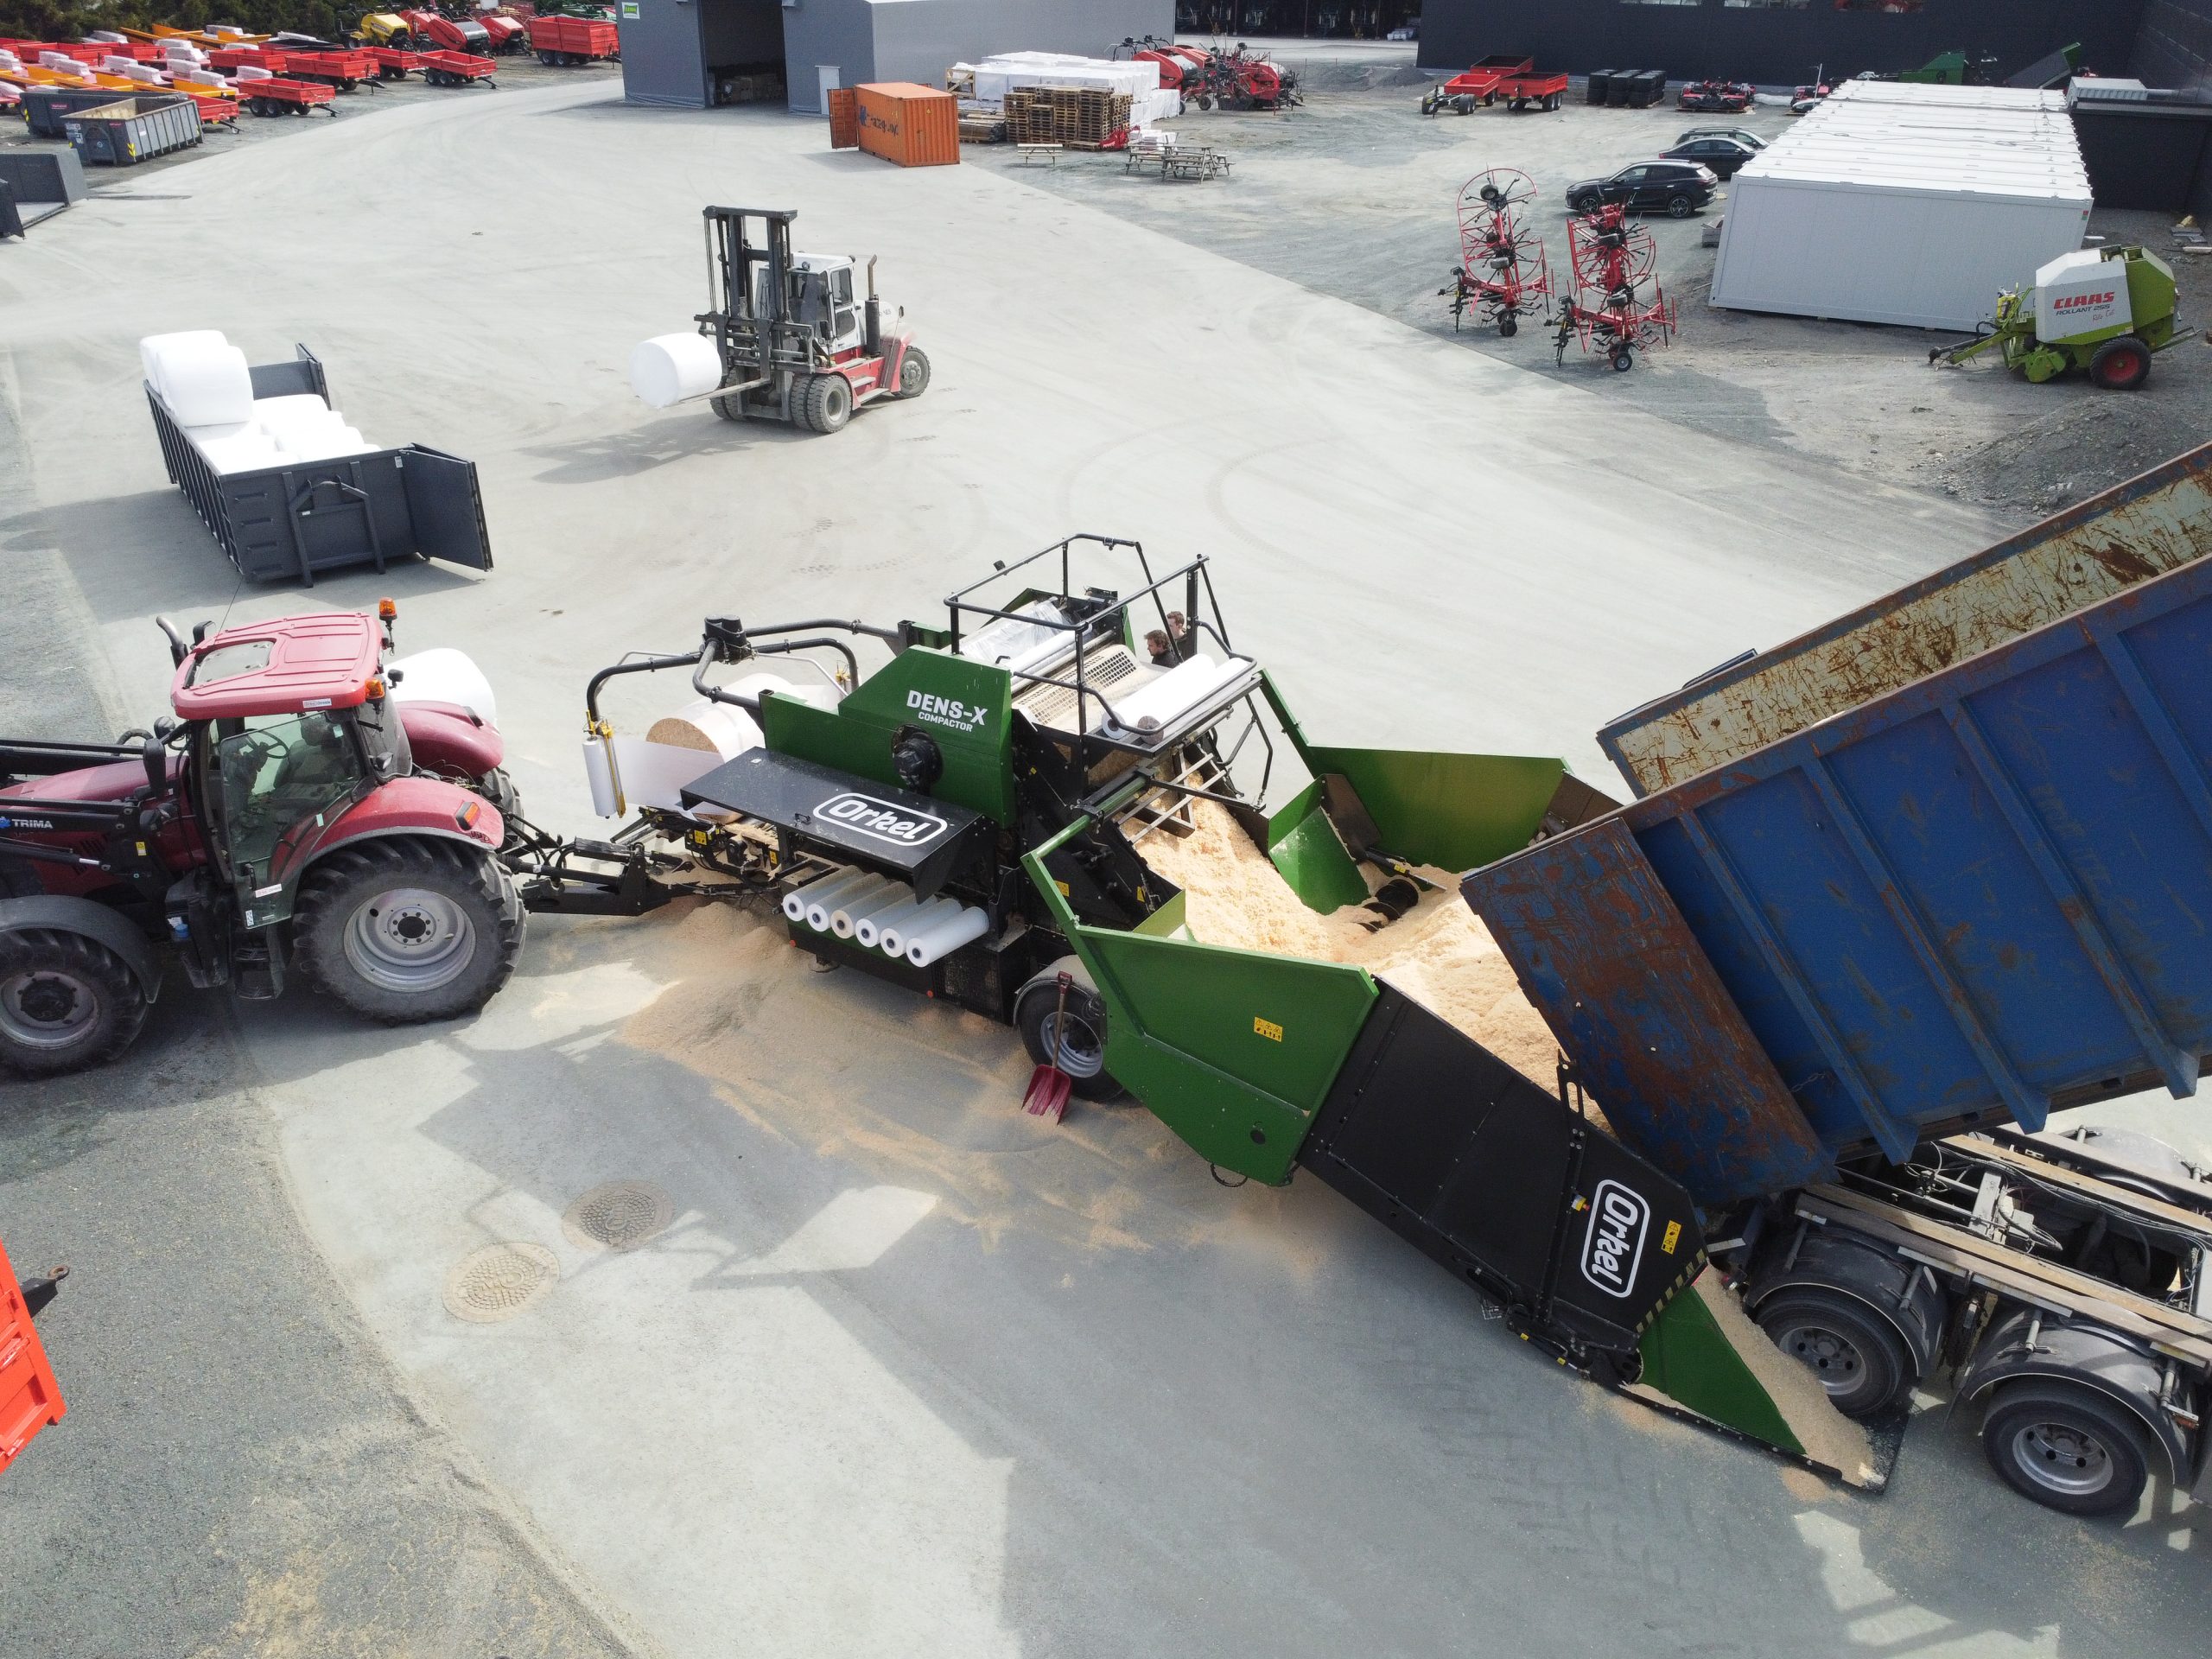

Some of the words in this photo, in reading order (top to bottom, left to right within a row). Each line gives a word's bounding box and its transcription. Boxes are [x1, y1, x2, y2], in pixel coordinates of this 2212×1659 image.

[2054, 292, 2115, 309] CLAAS
[2056, 306, 2092, 316] ROLLANT
[906, 690, 988, 726] DENS-X
[918, 711, 973, 733] COMPACTOR
[11, 818, 54, 829] TRIMA
[828, 799, 931, 840] Orkel
[1592, 1192, 1638, 1285] Orkel
